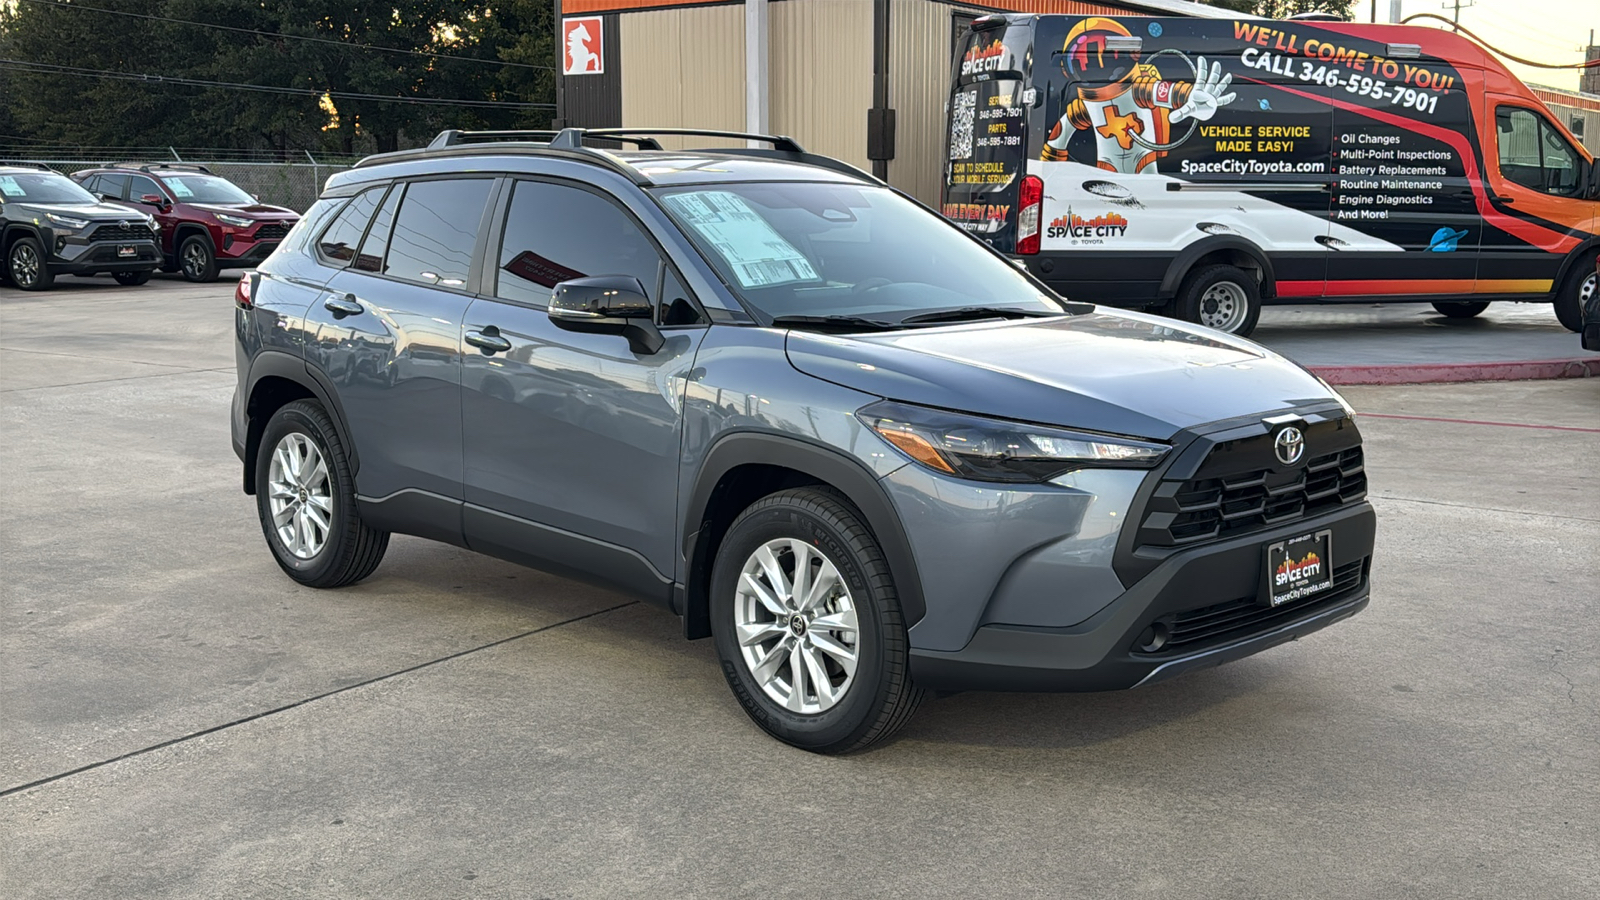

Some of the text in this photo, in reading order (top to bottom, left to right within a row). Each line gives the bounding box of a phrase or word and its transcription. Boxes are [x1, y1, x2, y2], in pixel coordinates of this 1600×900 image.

[1233, 20, 1454, 95] WE'LL COME TO YOU!
[961, 54, 1005, 75] SPACE CITY
[1240, 47, 1438, 114] CALL 346-595-7901
[979, 107, 1023, 120] 346-595-7901
[988, 123, 1007, 133] PARTS
[1200, 126, 1311, 138] VEHICLE SERVICE
[976, 136, 1020, 147] 346-595-7881
[1341, 134, 1401, 146] Oil Changes
[1215, 141, 1294, 152] MADE EASY!
[1340, 149, 1452, 161] Multi-Point Inspections
[967, 163, 974, 173] TO
[975, 162, 1004, 173] SCHEDULE
[1181, 159, 1325, 175] SpaceCityToyota.com
[1339, 165, 1447, 177] Battery Replacements
[1340, 180, 1443, 189] Routine Maintenance
[1339, 195, 1433, 206] Engine Diagnostics
[959, 203, 987, 220] EVERY
[987, 204, 1010, 222] DAY
[1337, 210, 1389, 219] And More!
[1047, 226, 1127, 238] SPACE CITY
[1275, 562, 1320, 586] SPACE CITY
[1273, 581, 1331, 605] SpaceCityToyota.com
